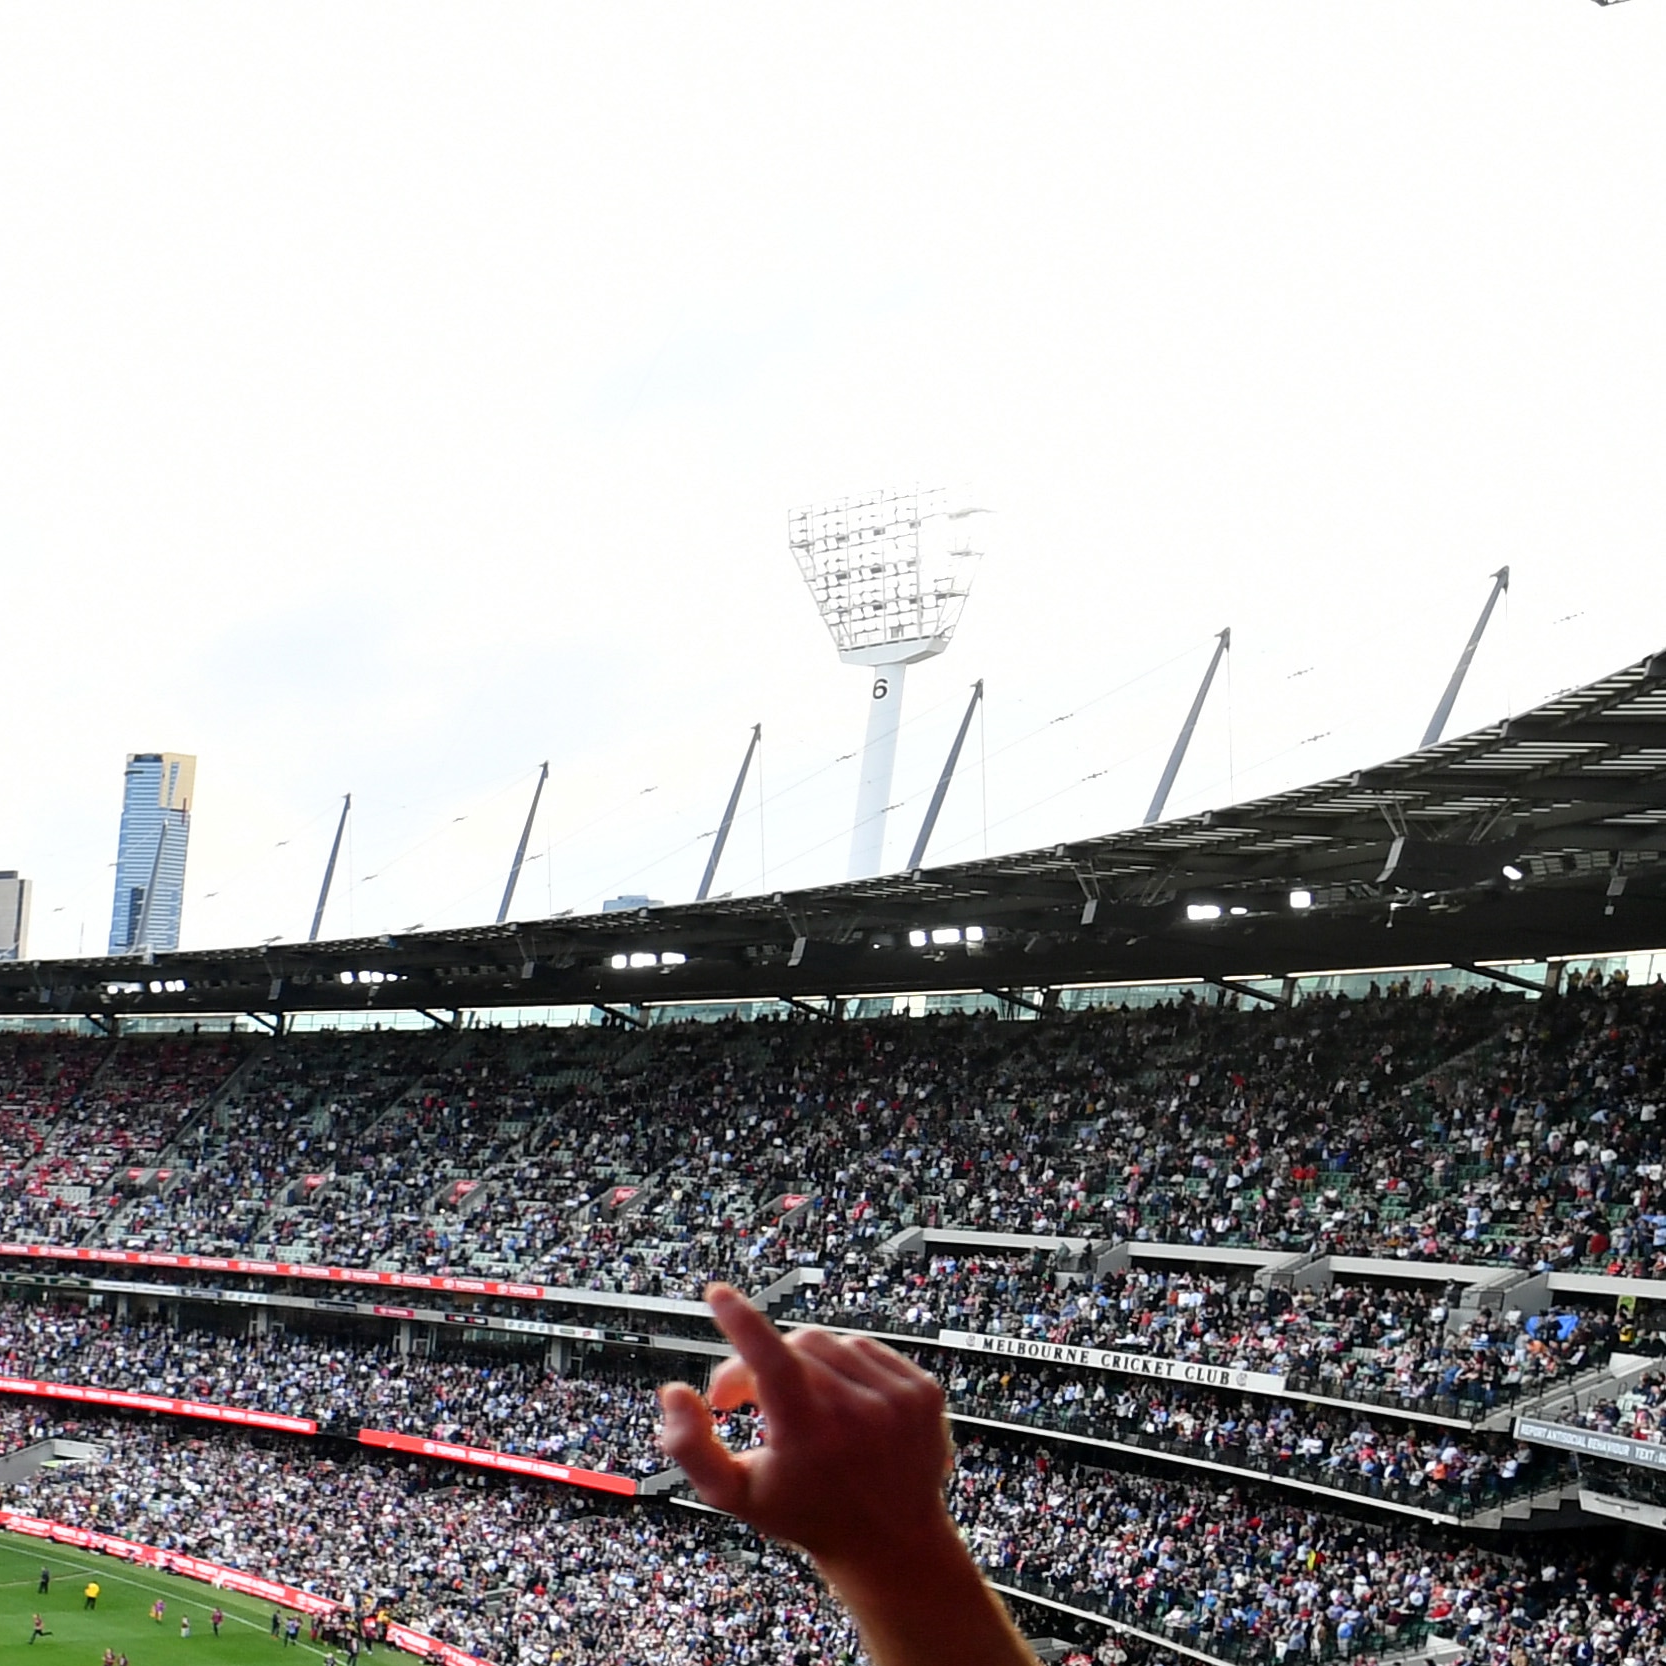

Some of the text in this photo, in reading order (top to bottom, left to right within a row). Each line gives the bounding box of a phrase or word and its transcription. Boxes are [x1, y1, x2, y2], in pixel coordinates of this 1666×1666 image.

[872, 679, 889, 700] 6
[983, 1337, 1230, 1385] MELBOURNE CRICKET CLUB
[1547, 1428, 1587, 1448] ANTISOCIAL
[1588, 1436, 1630, 1456] BEHAVIOUR
[1635, 1446, 1654, 1461] TEXT
